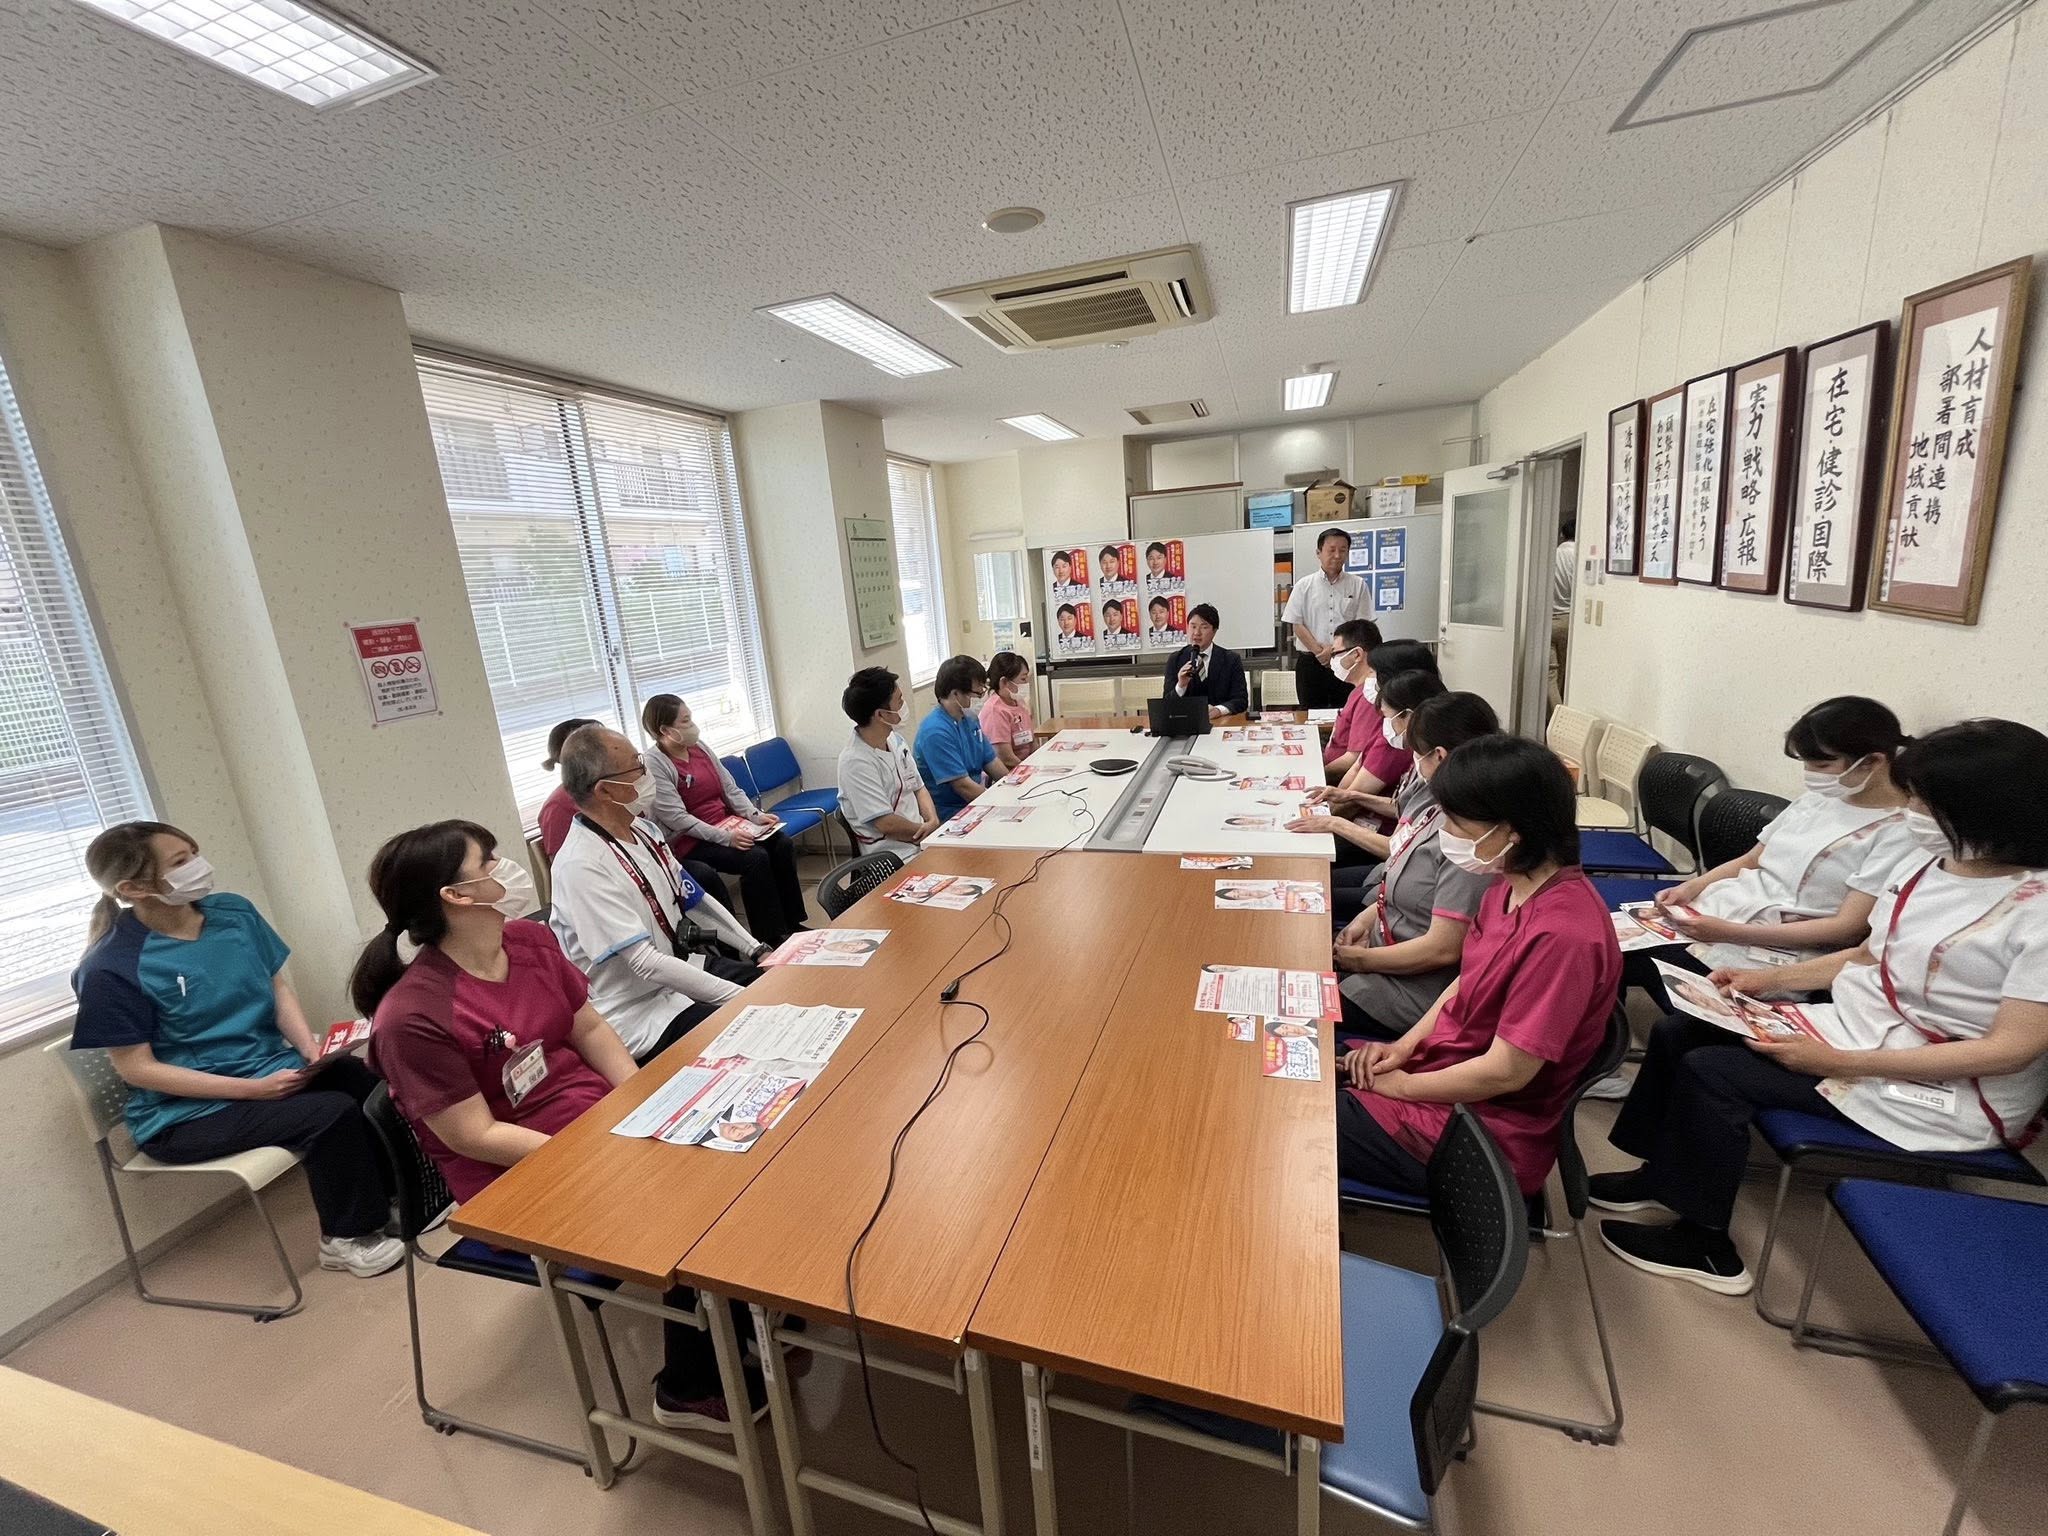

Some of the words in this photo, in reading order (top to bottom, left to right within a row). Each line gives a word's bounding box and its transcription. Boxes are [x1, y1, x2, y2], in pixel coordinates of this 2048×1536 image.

[1924, 364, 1961, 525] 部署間連携
[1954, 328, 1993, 459] 人材育成
[1901, 433, 1929, 548] 地域貢献
